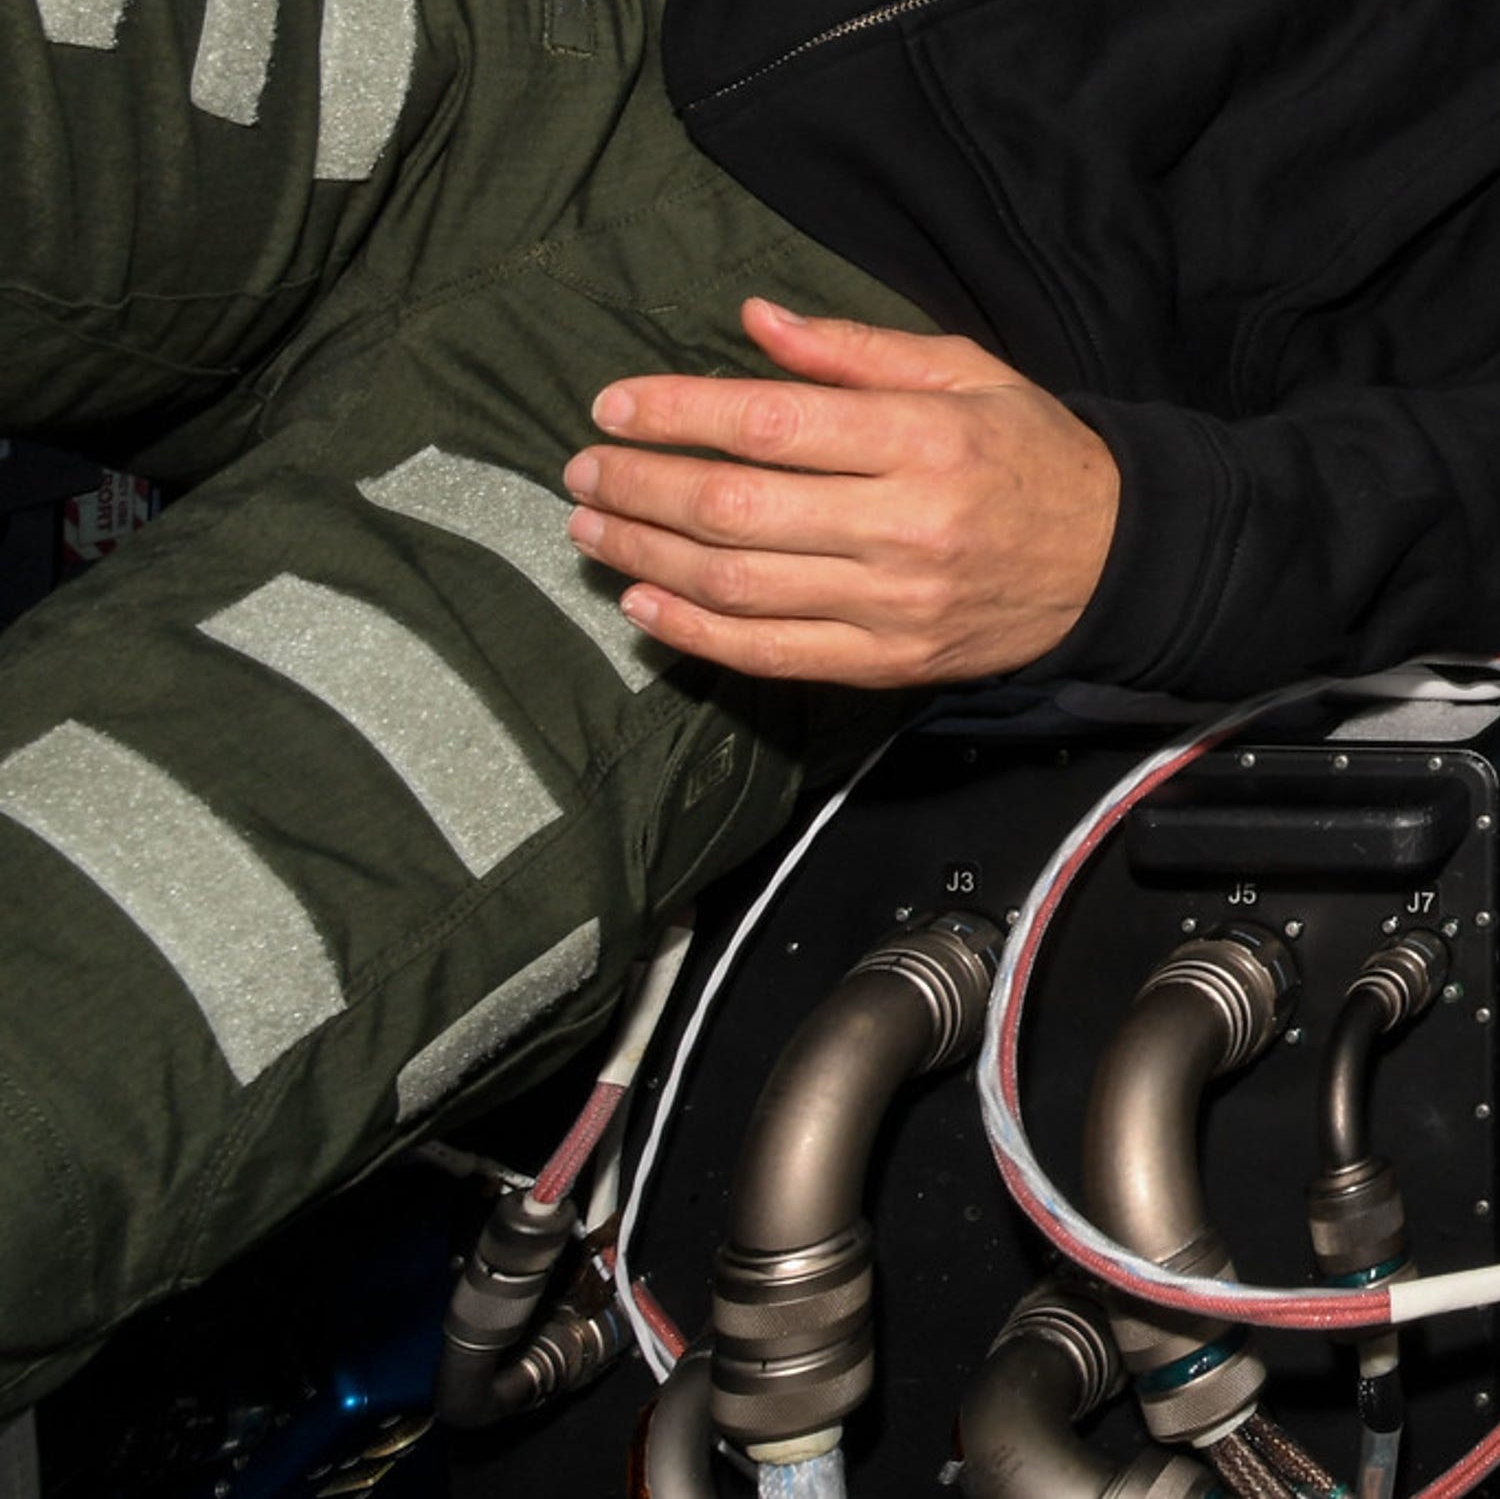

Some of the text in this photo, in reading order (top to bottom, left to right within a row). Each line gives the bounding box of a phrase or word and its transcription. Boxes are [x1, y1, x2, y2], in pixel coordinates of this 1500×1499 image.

[945, 869, 975, 893] J3
[1227, 883, 1258, 905] J5
[1406, 891, 1436, 914] J7
